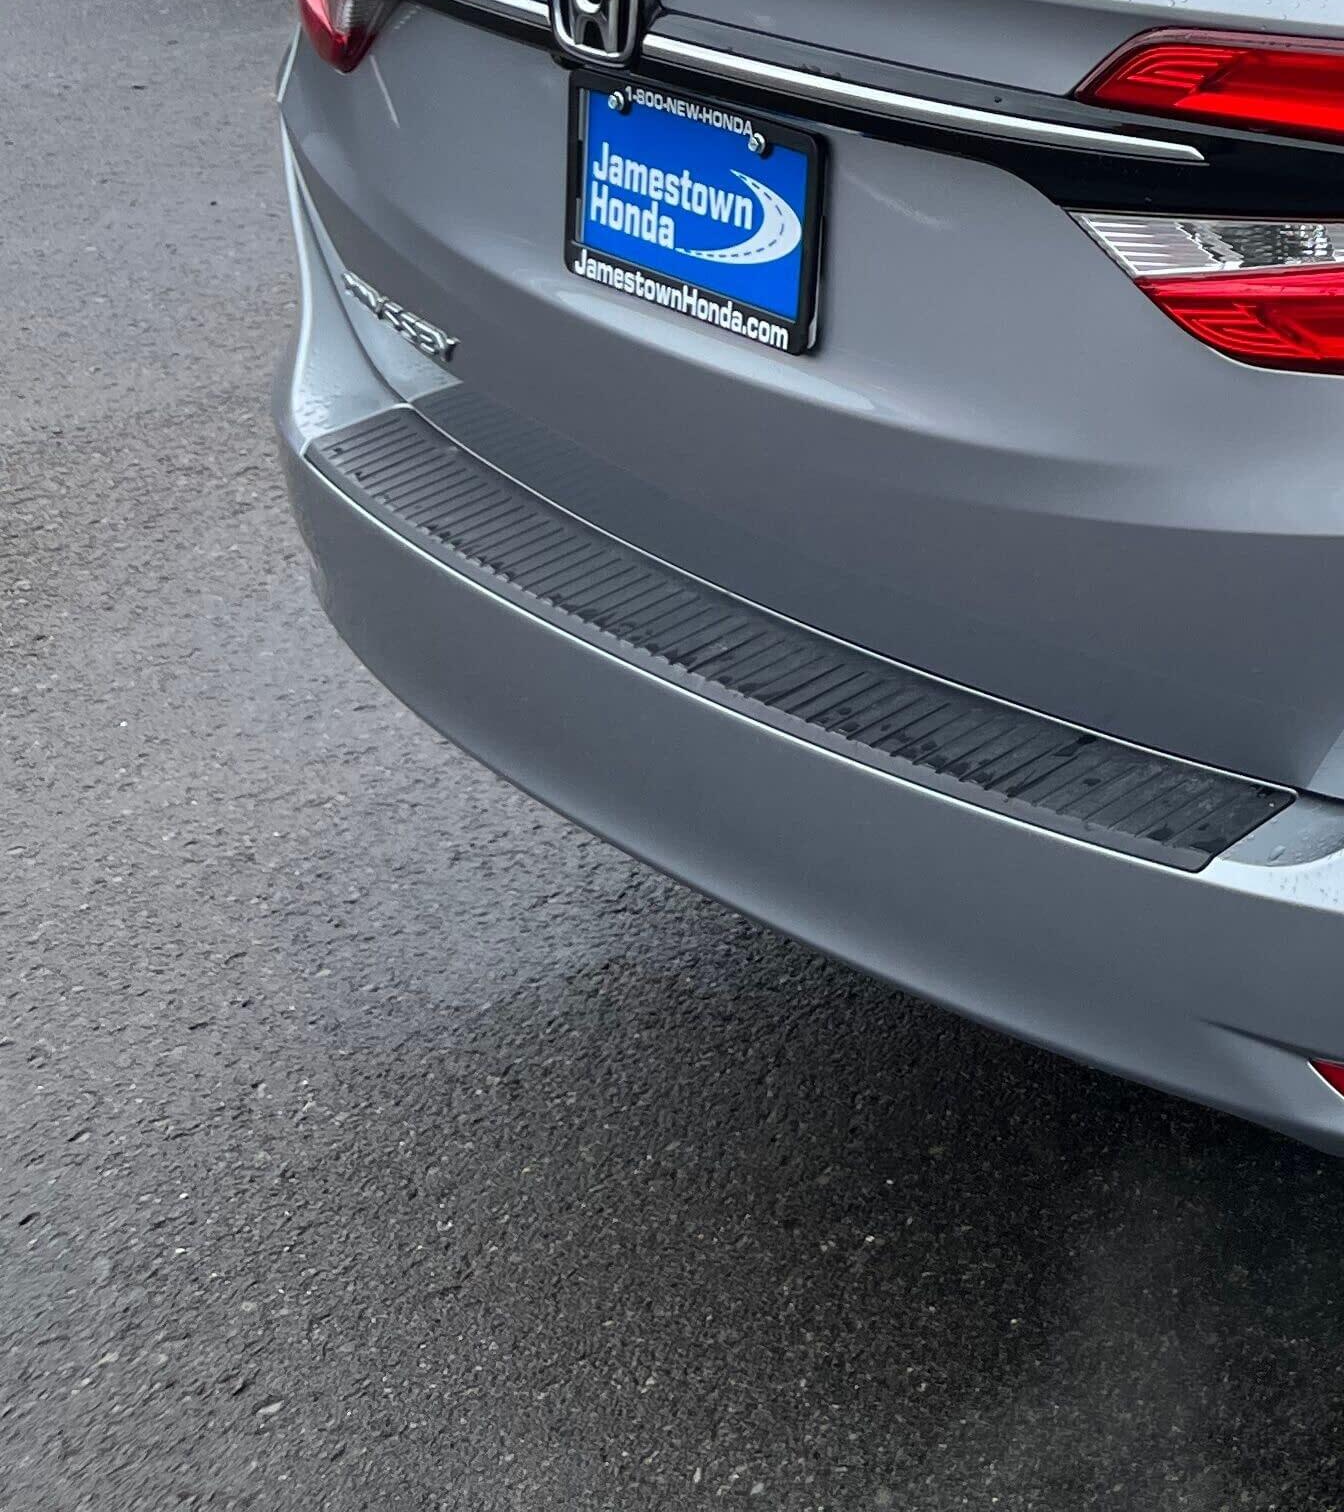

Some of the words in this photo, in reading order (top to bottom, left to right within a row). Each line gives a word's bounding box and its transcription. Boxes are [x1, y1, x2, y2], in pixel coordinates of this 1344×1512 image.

[625, 87, 753, 137] 1-800-NEW-HONDA
[589, 181, 675, 251] Honda
[592, 142, 753, 231] Jamestown
[574, 250, 789, 350] JamestownHonda.com
